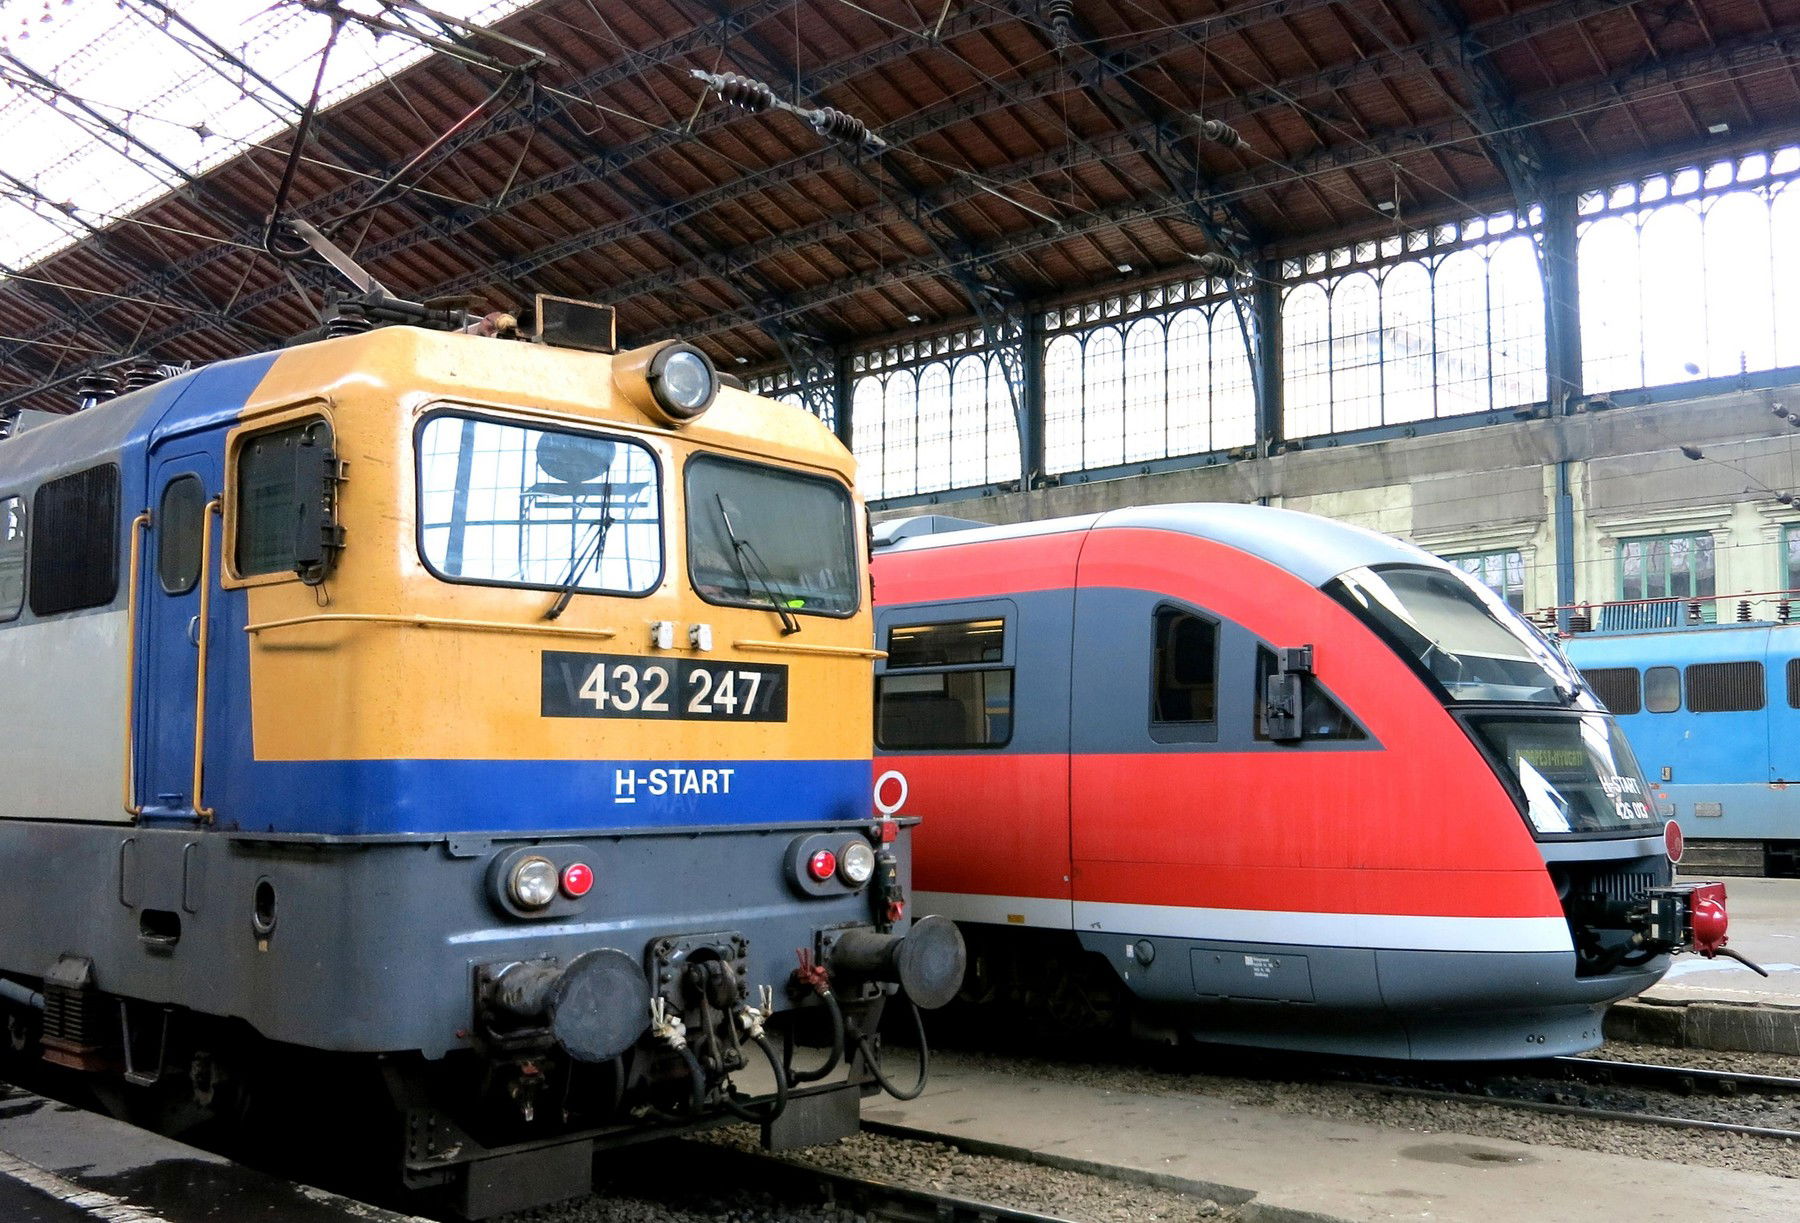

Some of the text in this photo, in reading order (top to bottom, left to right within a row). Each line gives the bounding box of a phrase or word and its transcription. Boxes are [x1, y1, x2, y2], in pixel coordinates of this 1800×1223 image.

[578, 662, 762, 716] 432 247
[614, 768, 735, 804] H-START
[1598, 775, 1641, 798] H-START
[1615, 801, 1635, 820] 426
